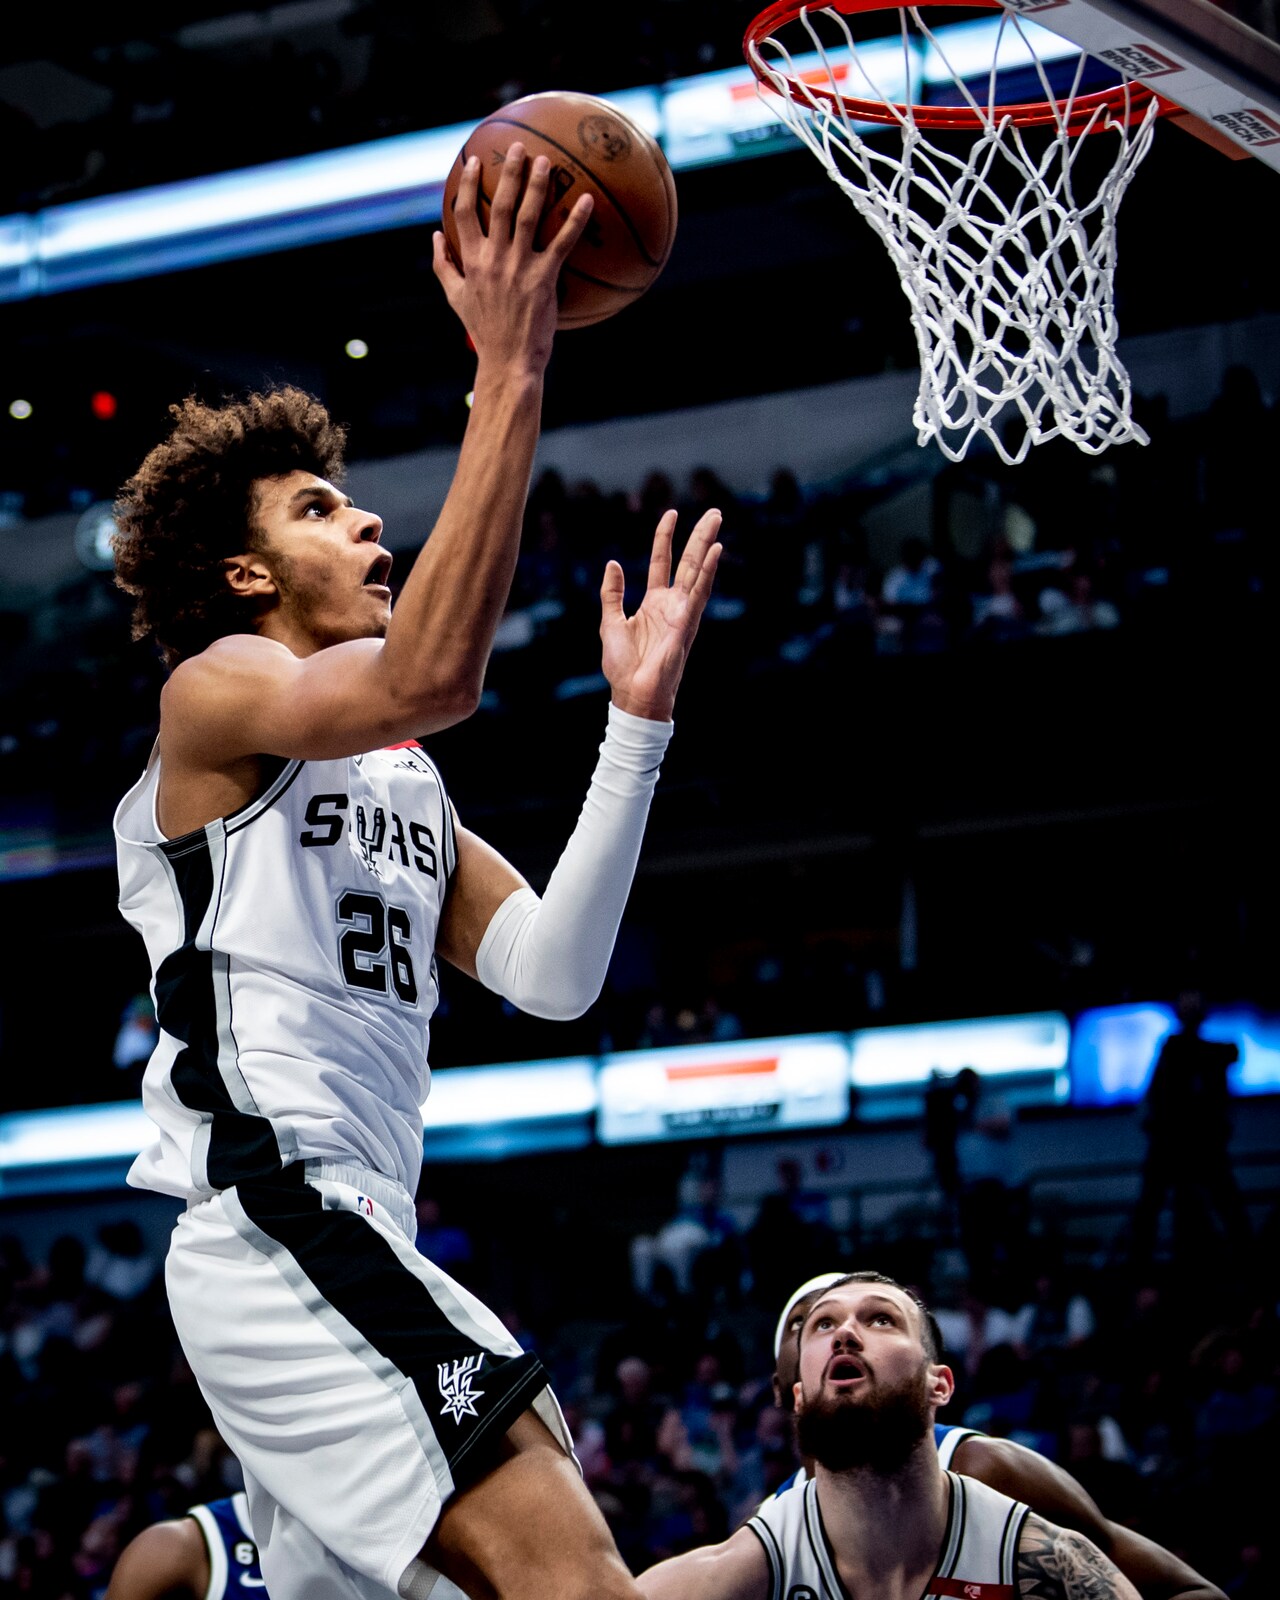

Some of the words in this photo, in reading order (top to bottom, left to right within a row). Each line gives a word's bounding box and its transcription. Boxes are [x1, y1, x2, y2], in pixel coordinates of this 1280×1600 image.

[1098, 50, 1148, 75] BRICK
[1115, 47, 1165, 72] ACME
[1212, 114, 1260, 142] BRICK
[1227, 111, 1277, 140] ACME
[300, 793, 438, 881] SURS
[336, 887, 418, 1008] 26
[235, 1542, 254, 1566] 6
